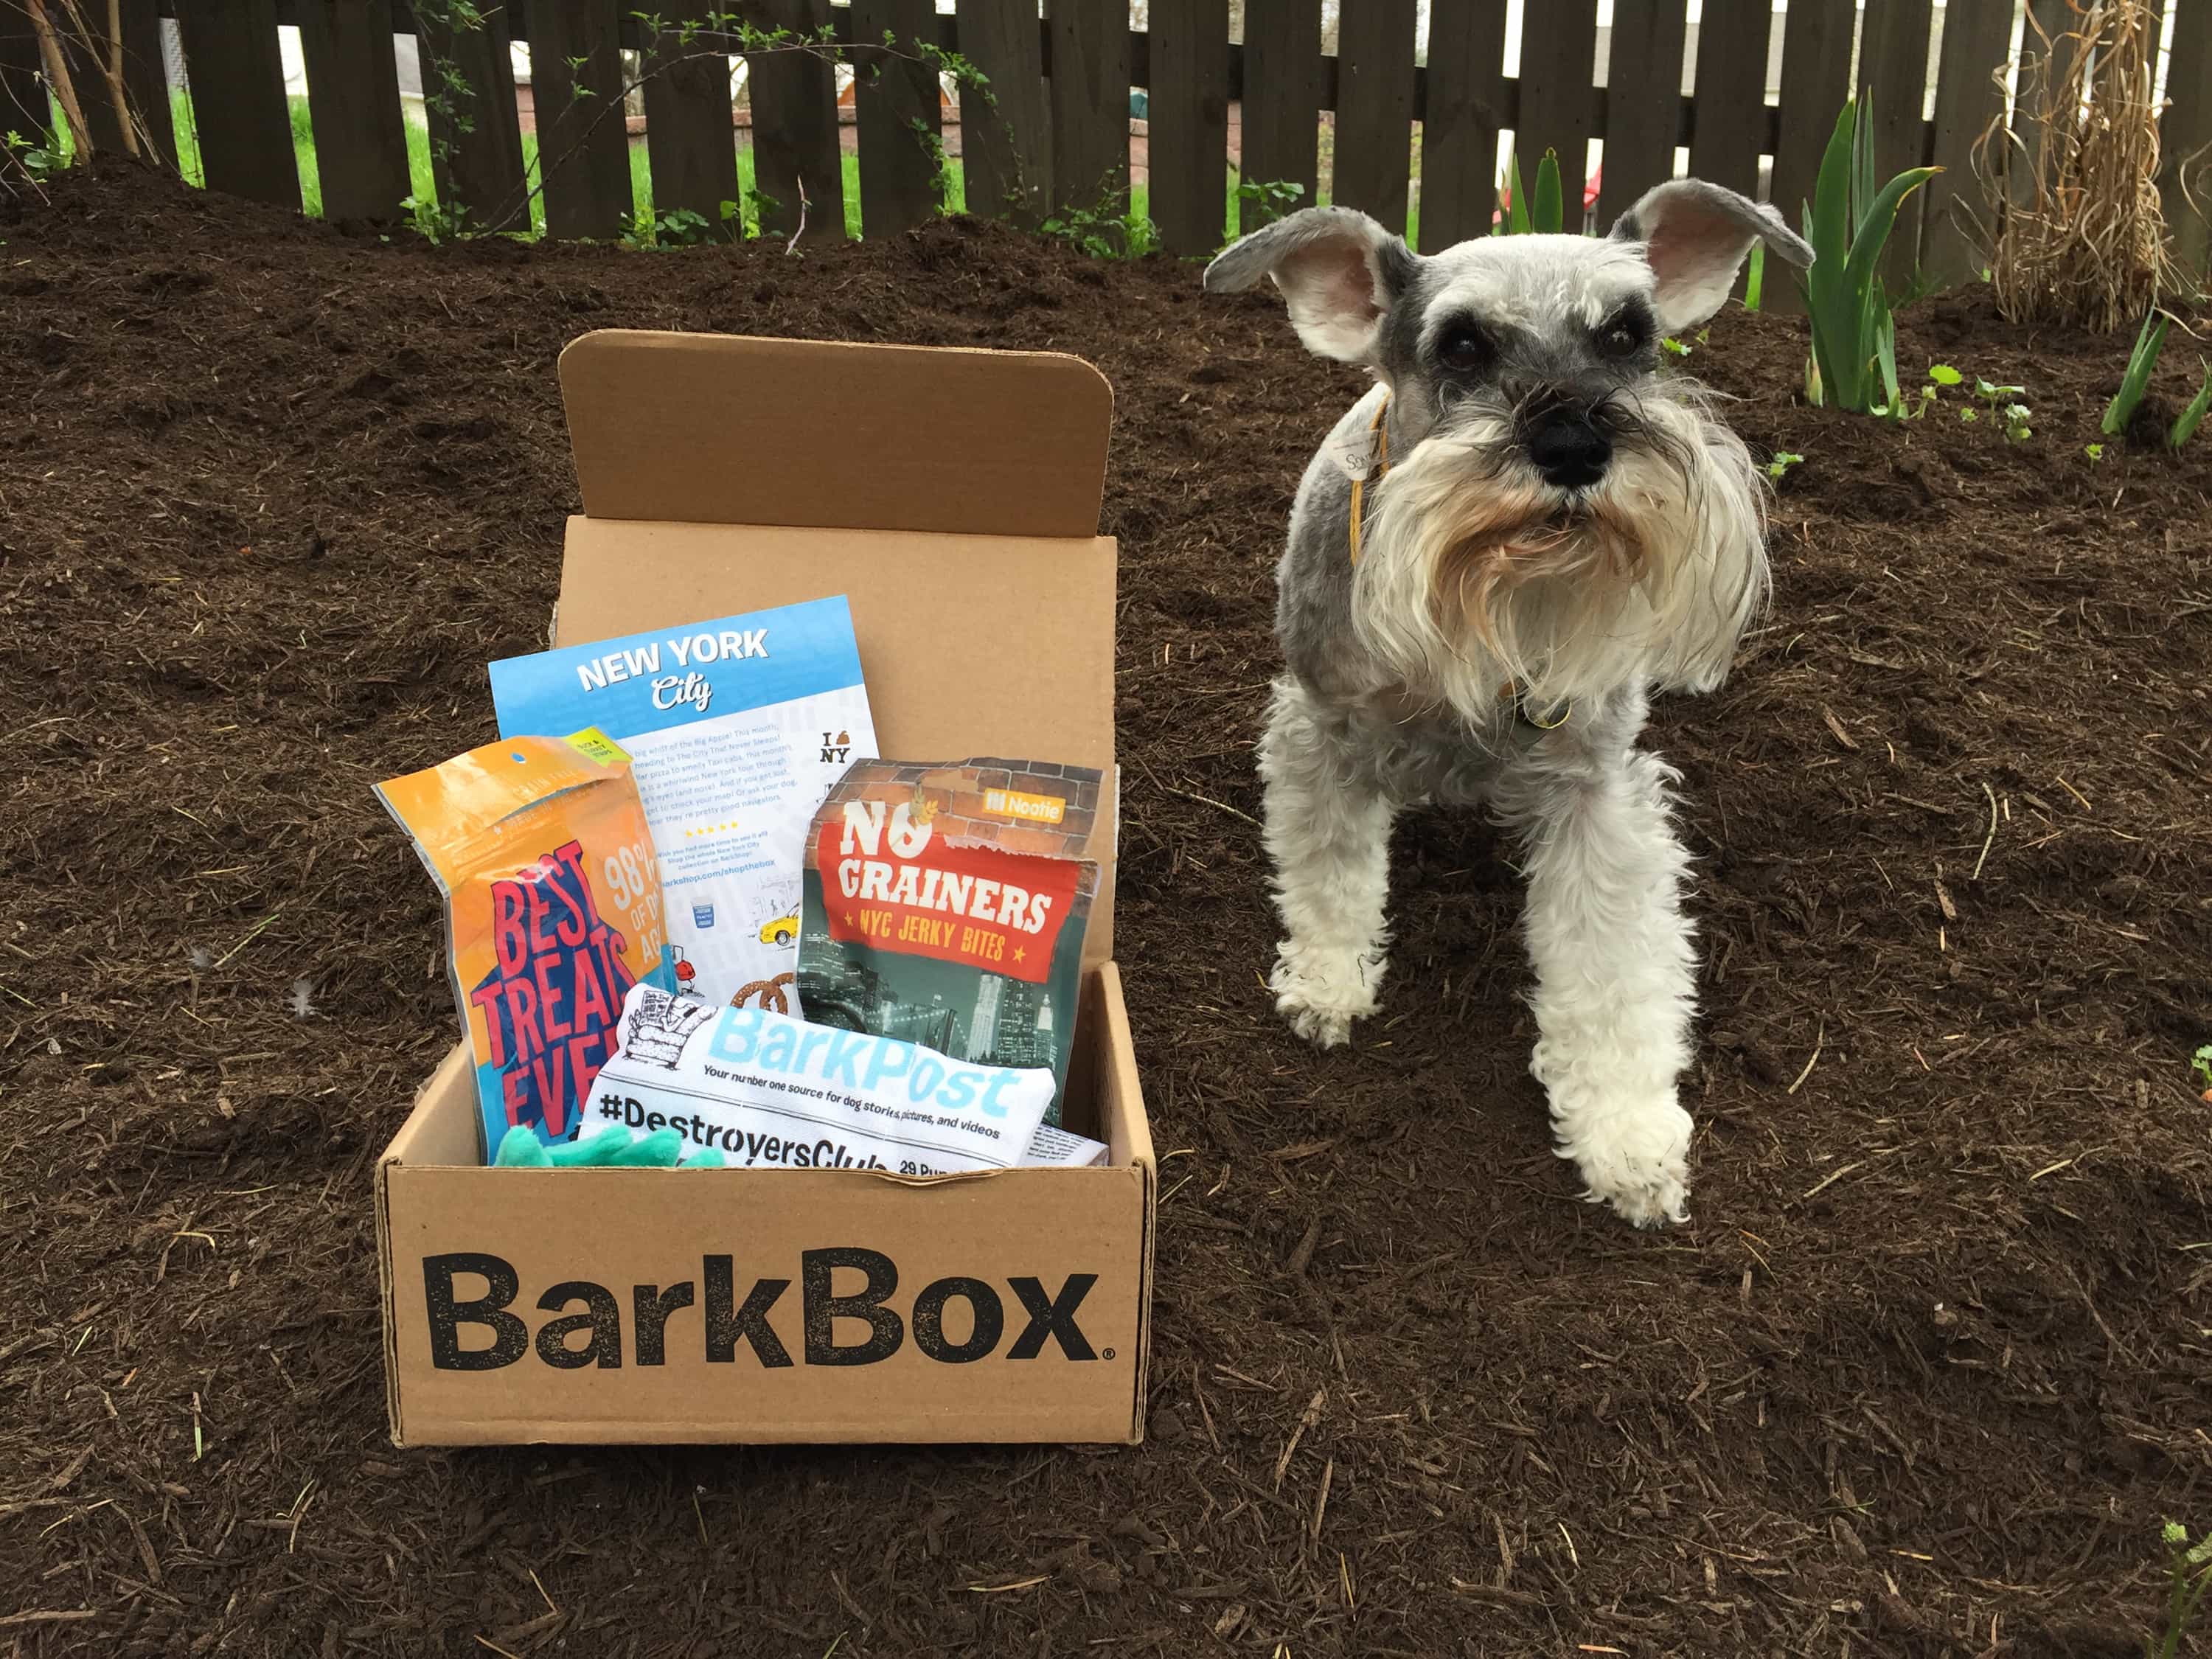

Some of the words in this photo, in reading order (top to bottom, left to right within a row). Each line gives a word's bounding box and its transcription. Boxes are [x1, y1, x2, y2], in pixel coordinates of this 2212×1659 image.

[576, 641, 661, 692] NEW
[667, 628, 770, 667] YORK
[650, 672, 712, 712] City
[820, 748, 849, 765] NY
[822, 732, 832, 746] I
[839, 801, 933, 859] NO
[1008, 796, 1060, 820] Nootie
[604, 840, 655, 911] 98%
[838, 858, 1053, 935] GRAINERS
[490, 839, 599, 981] BEST
[860, 909, 893, 939] NYC
[898, 914, 956, 949] JERKY
[961, 926, 1006, 961] BITES
[470, 931, 637, 1070] TREATS
[708, 1006, 1022, 1119] BarkPost
[703, 1064, 729, 1079] Your
[731, 1072, 768, 1088] number
[768, 1079, 786, 1092] one
[788, 1084, 824, 1100] source
[826, 1091, 841, 1103] for
[844, 1095, 862, 1113] dog
[937, 1116, 959, 1129] and
[961, 1120, 1001, 1140] videos
[900, 1160, 917, 1175] 29
